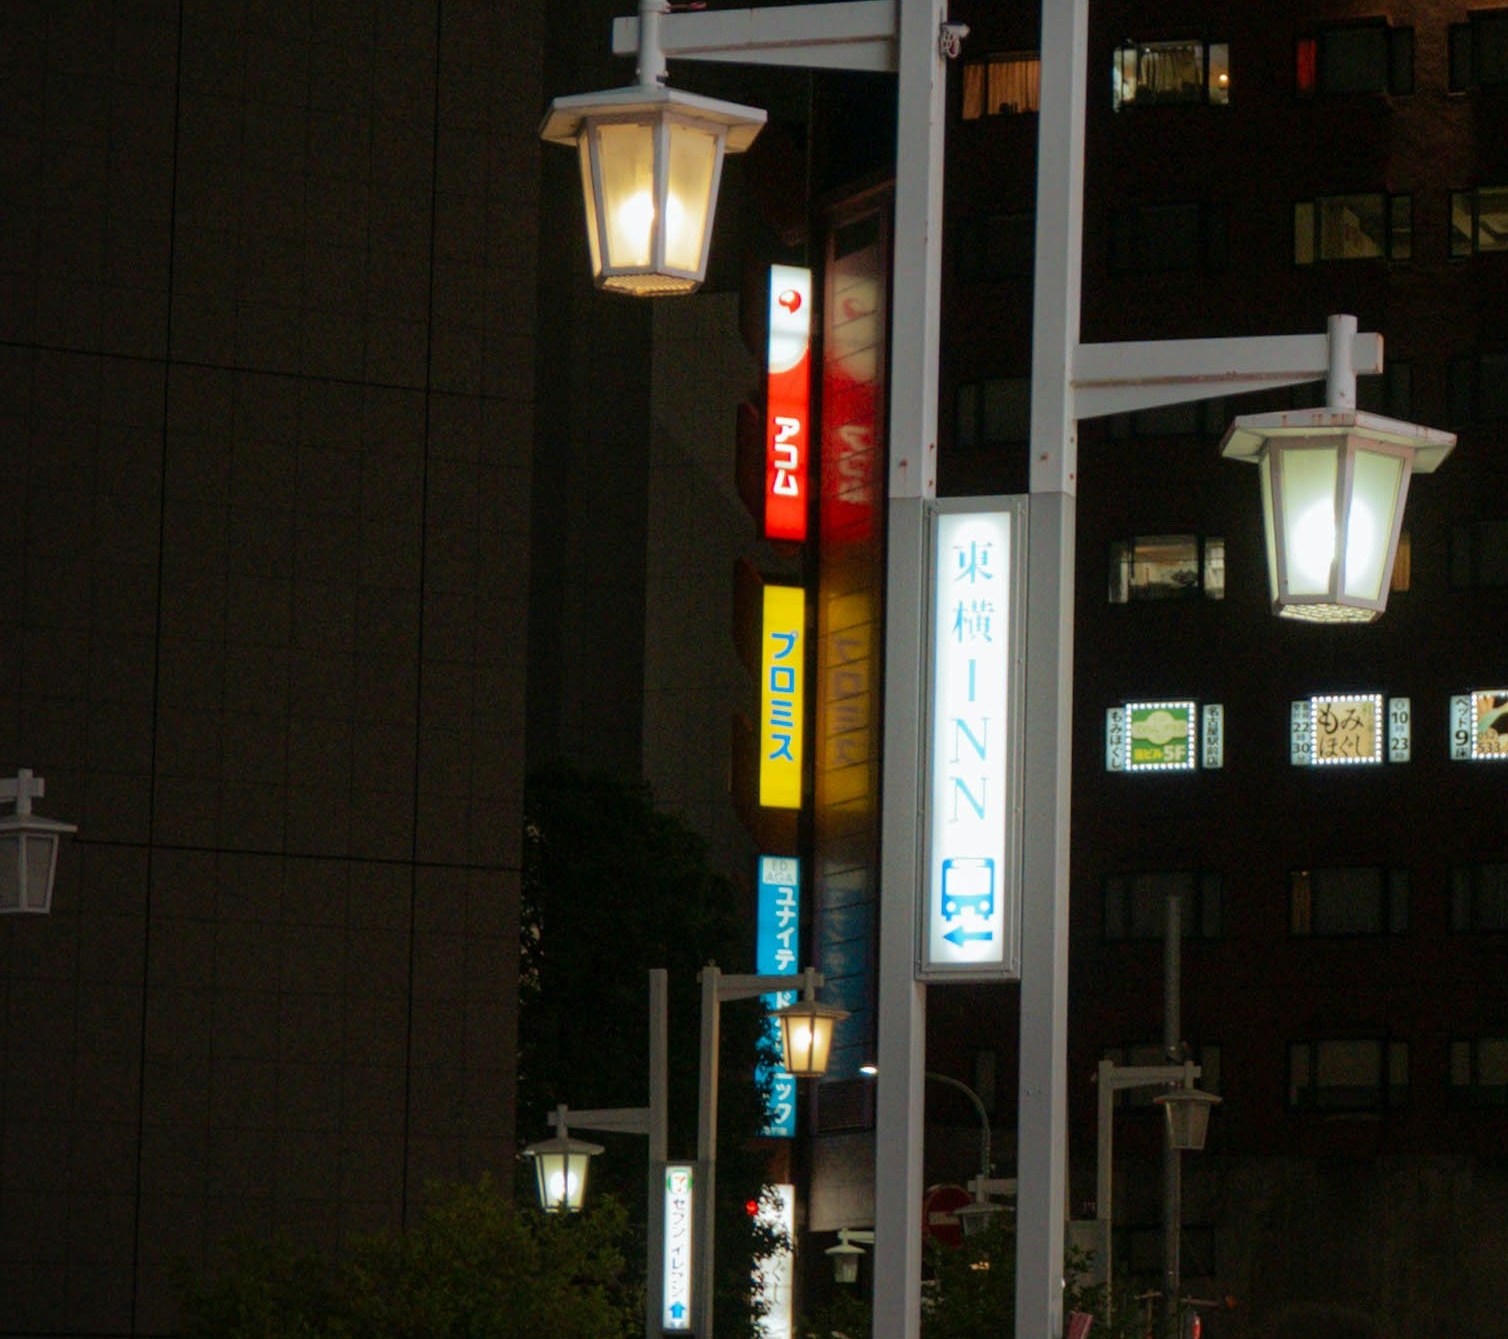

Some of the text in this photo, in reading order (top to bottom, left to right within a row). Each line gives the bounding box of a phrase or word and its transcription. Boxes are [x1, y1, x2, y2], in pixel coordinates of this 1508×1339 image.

[773, 417, 800, 496] アコム
[769, 630, 799, 761] プロミス
[948, 539, 996, 825] 東横INN
[1317, 702, 1363, 734] もみ
[1318, 734, 1361, 757] ほぐし
